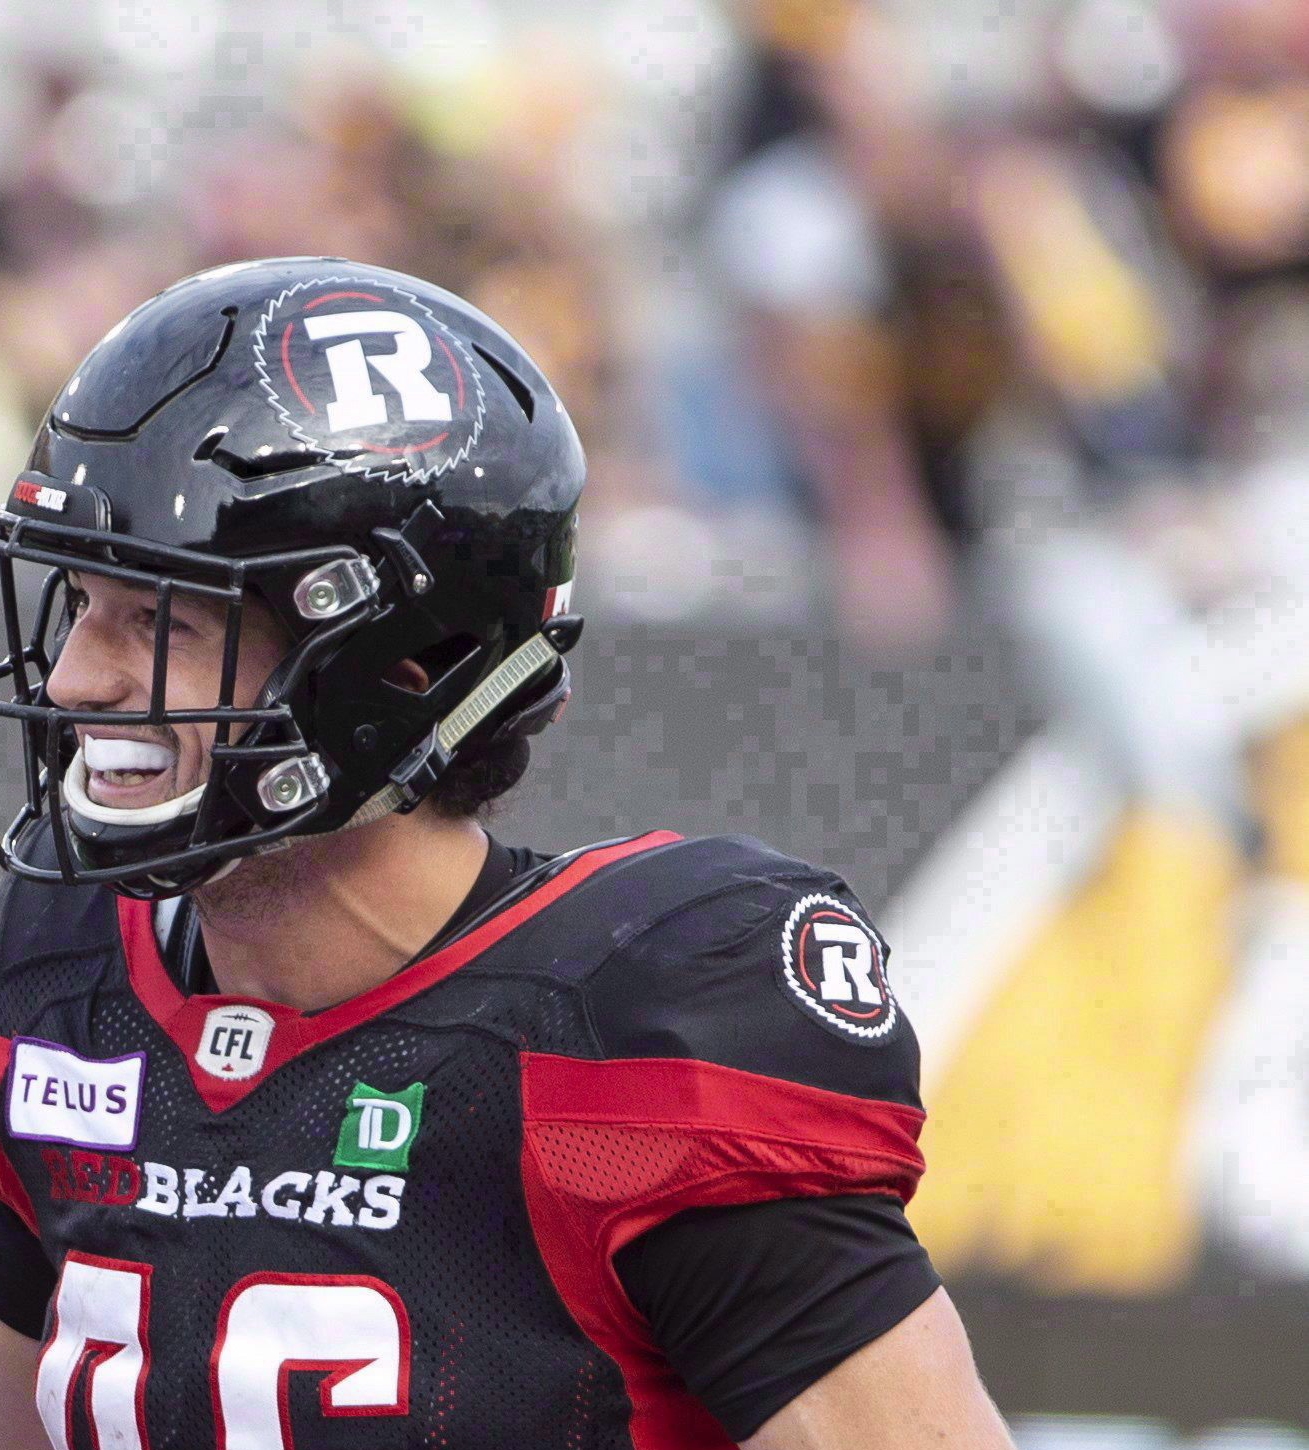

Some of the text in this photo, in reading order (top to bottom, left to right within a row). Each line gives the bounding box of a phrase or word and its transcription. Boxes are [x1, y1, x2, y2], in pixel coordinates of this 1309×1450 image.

[304, 310, 453, 433] R
[813, 922, 883, 1006] R
[209, 1026, 253, 1060] CFL
[21, 1073, 128, 1115] TELUS
[352, 1098, 412, 1150] TD
